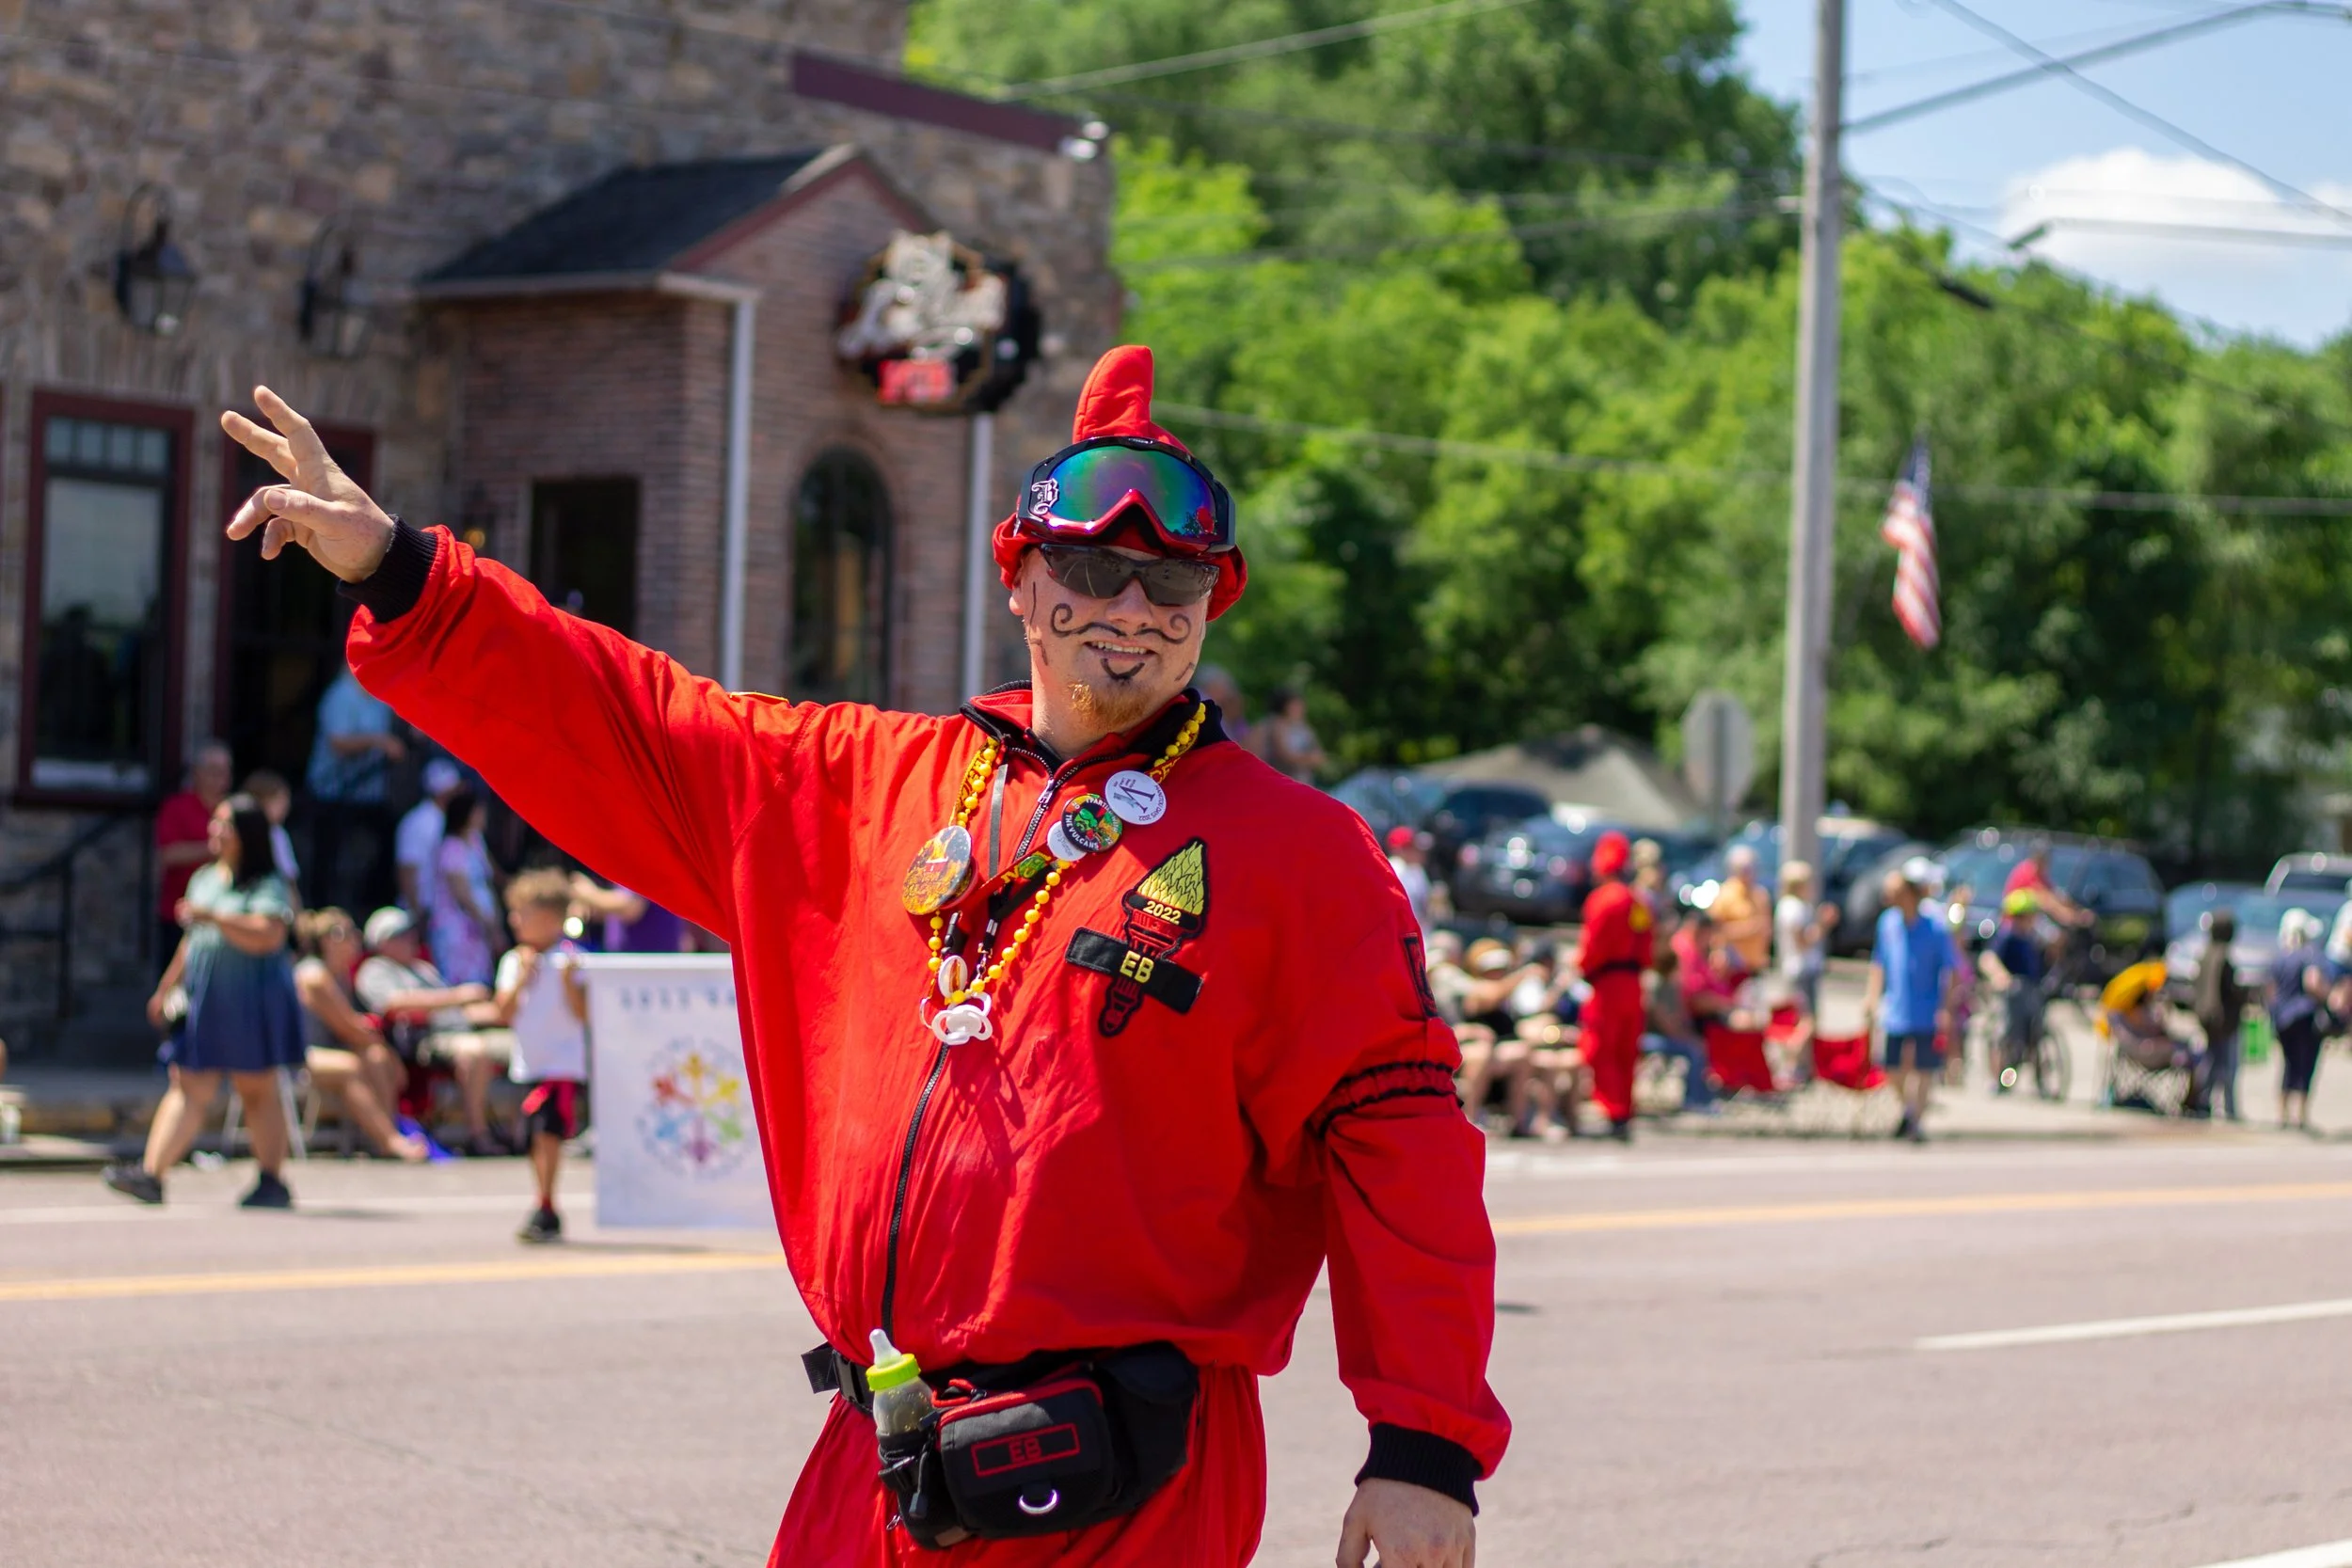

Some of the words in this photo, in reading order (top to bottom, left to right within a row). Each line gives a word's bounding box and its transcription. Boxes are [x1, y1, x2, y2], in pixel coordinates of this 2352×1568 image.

[1065, 814, 1073, 828] THE
[1151, 806, 1162, 818] DAYS
[1143, 900, 1182, 925] 2022
[1120, 950, 1154, 984] EB
[1009, 1436, 1041, 1464] EB
